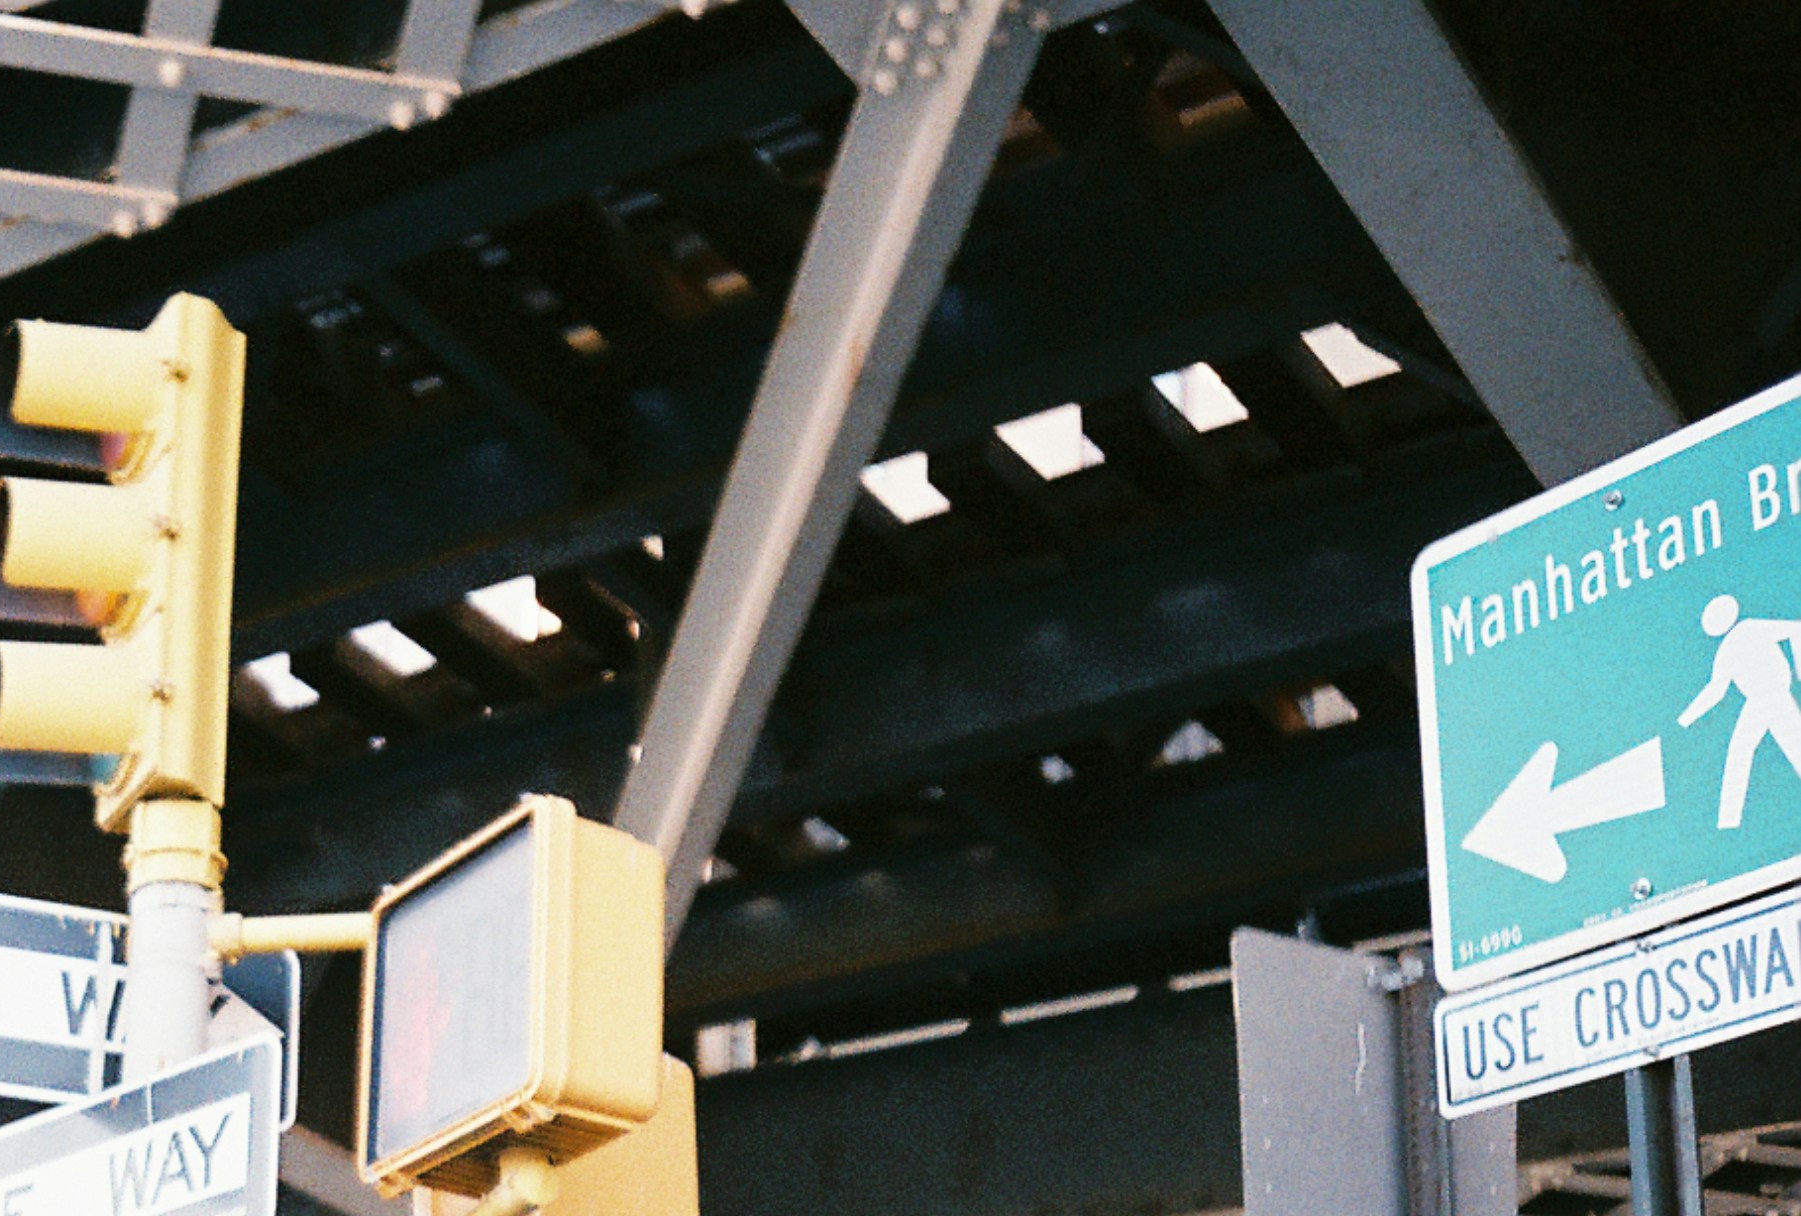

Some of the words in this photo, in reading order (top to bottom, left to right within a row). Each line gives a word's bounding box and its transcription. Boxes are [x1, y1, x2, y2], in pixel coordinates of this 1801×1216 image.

[1441, 498, 1723, 666] Manhattan
[1462, 1001, 1544, 1081] USE
[1574, 919, 1801, 1049] CROSSWA
